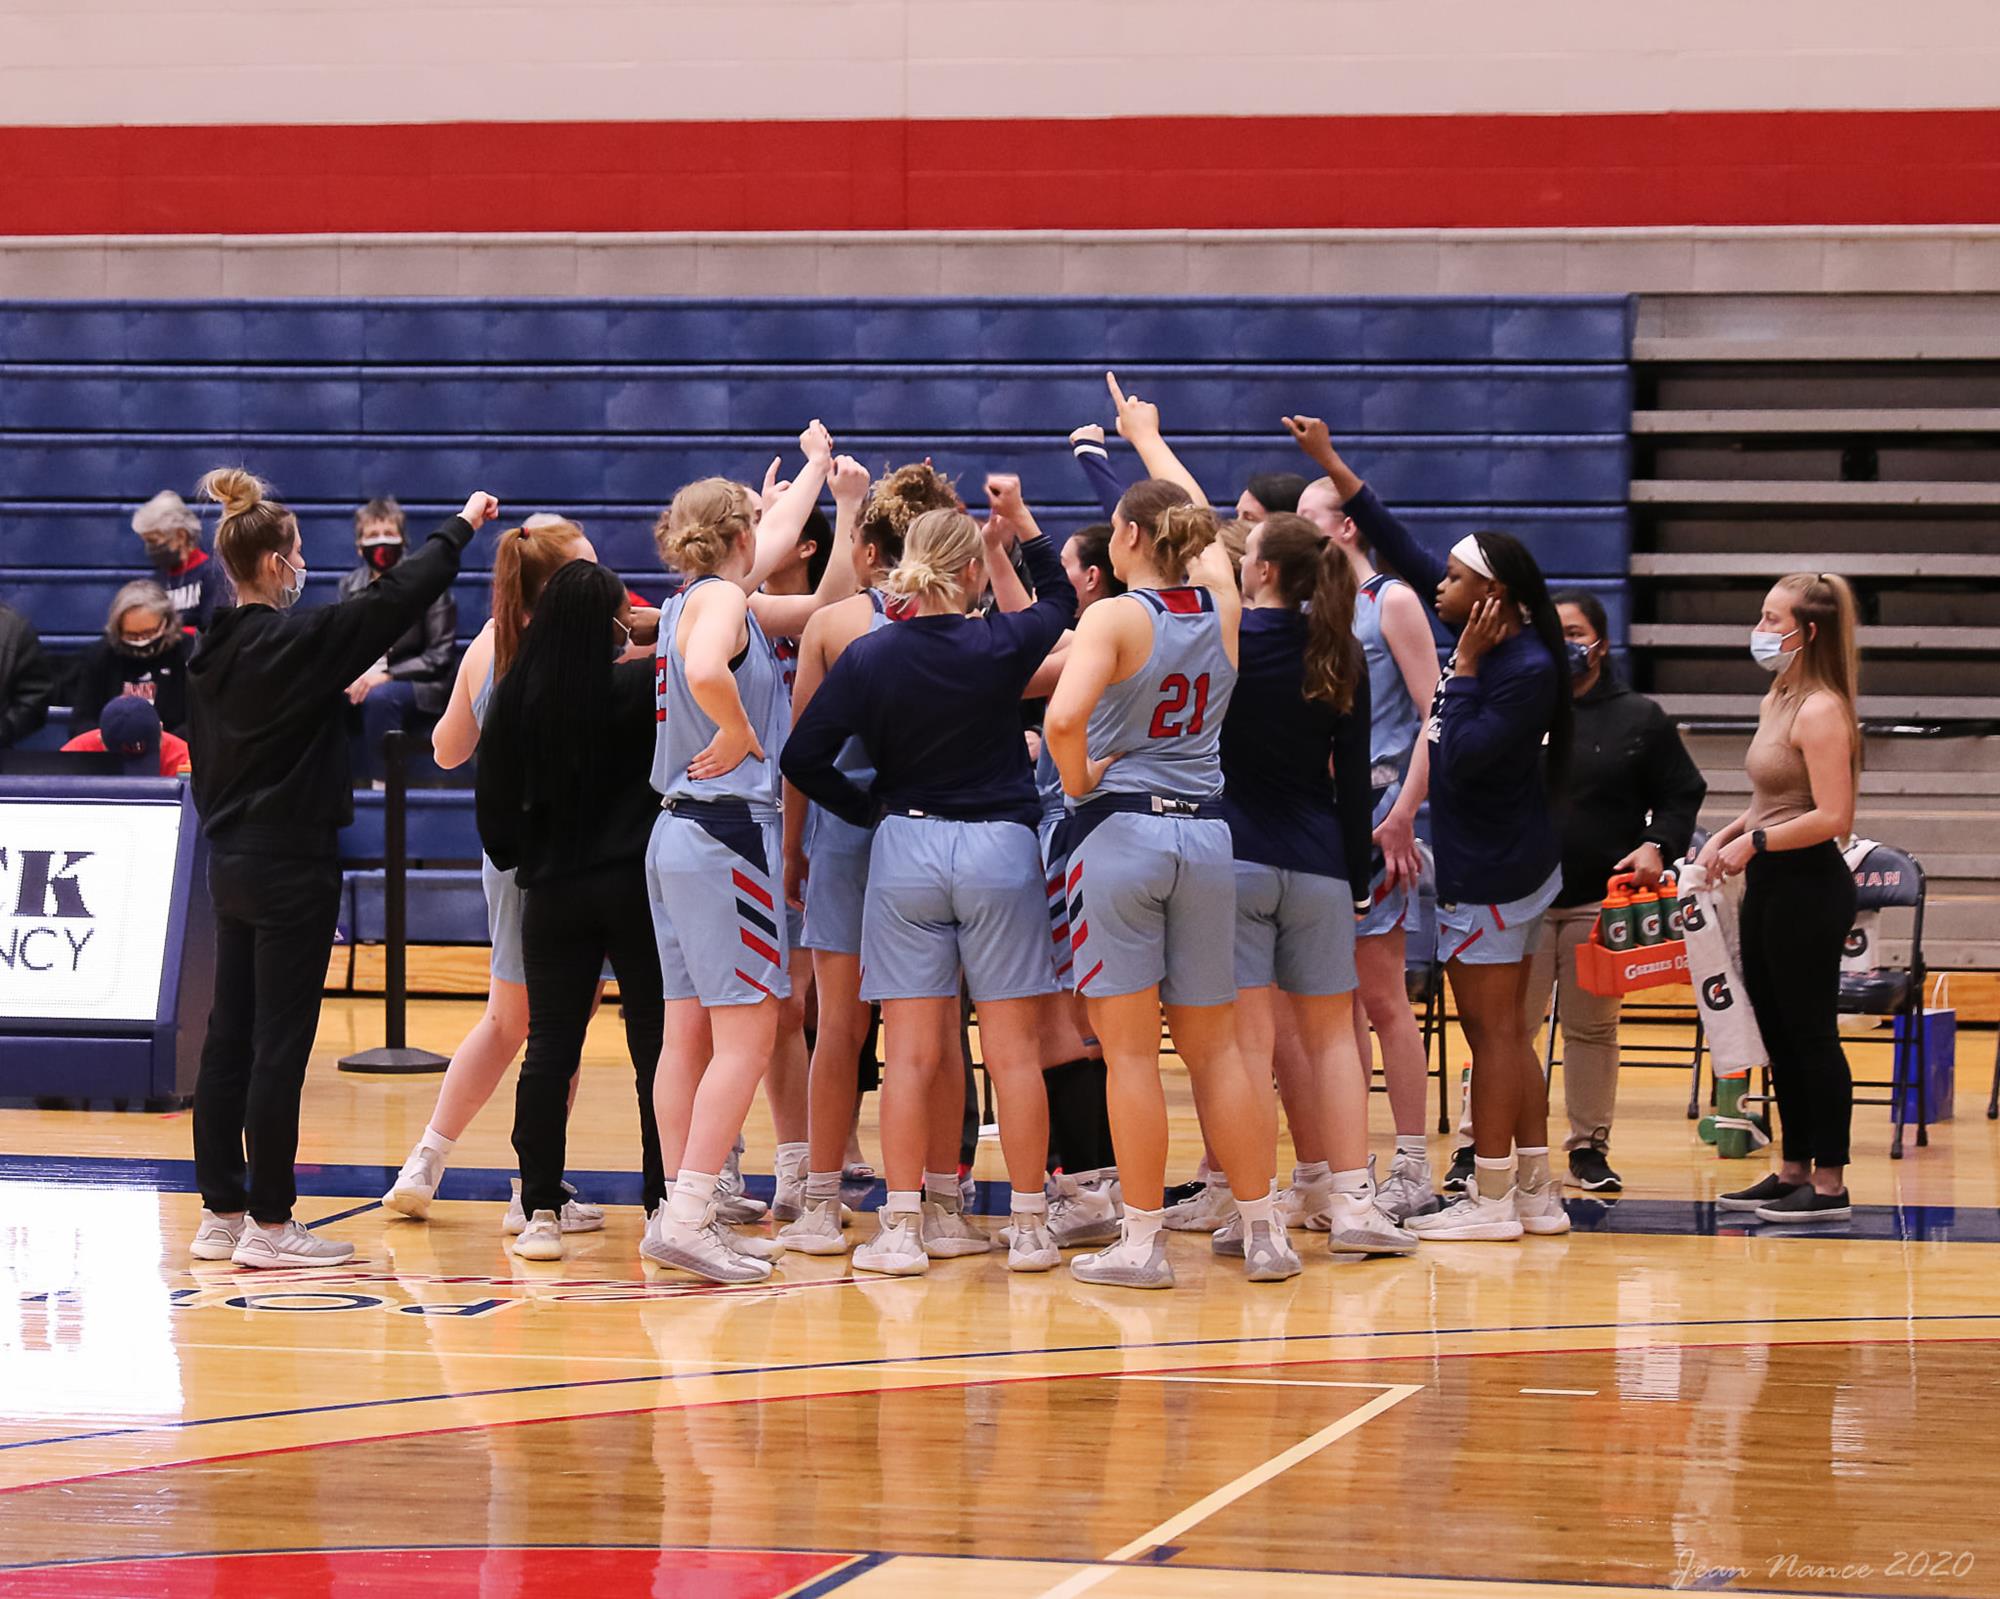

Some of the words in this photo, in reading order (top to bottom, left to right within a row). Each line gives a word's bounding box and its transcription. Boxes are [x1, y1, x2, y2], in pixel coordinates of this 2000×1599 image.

[1148, 672, 1210, 738] 21
[0, 846, 95, 918] K
[1608, 920, 1627, 943] G
[1641, 914, 1660, 936] G
[1680, 894, 1706, 932] G
[1702, 972, 1734, 1011] G
